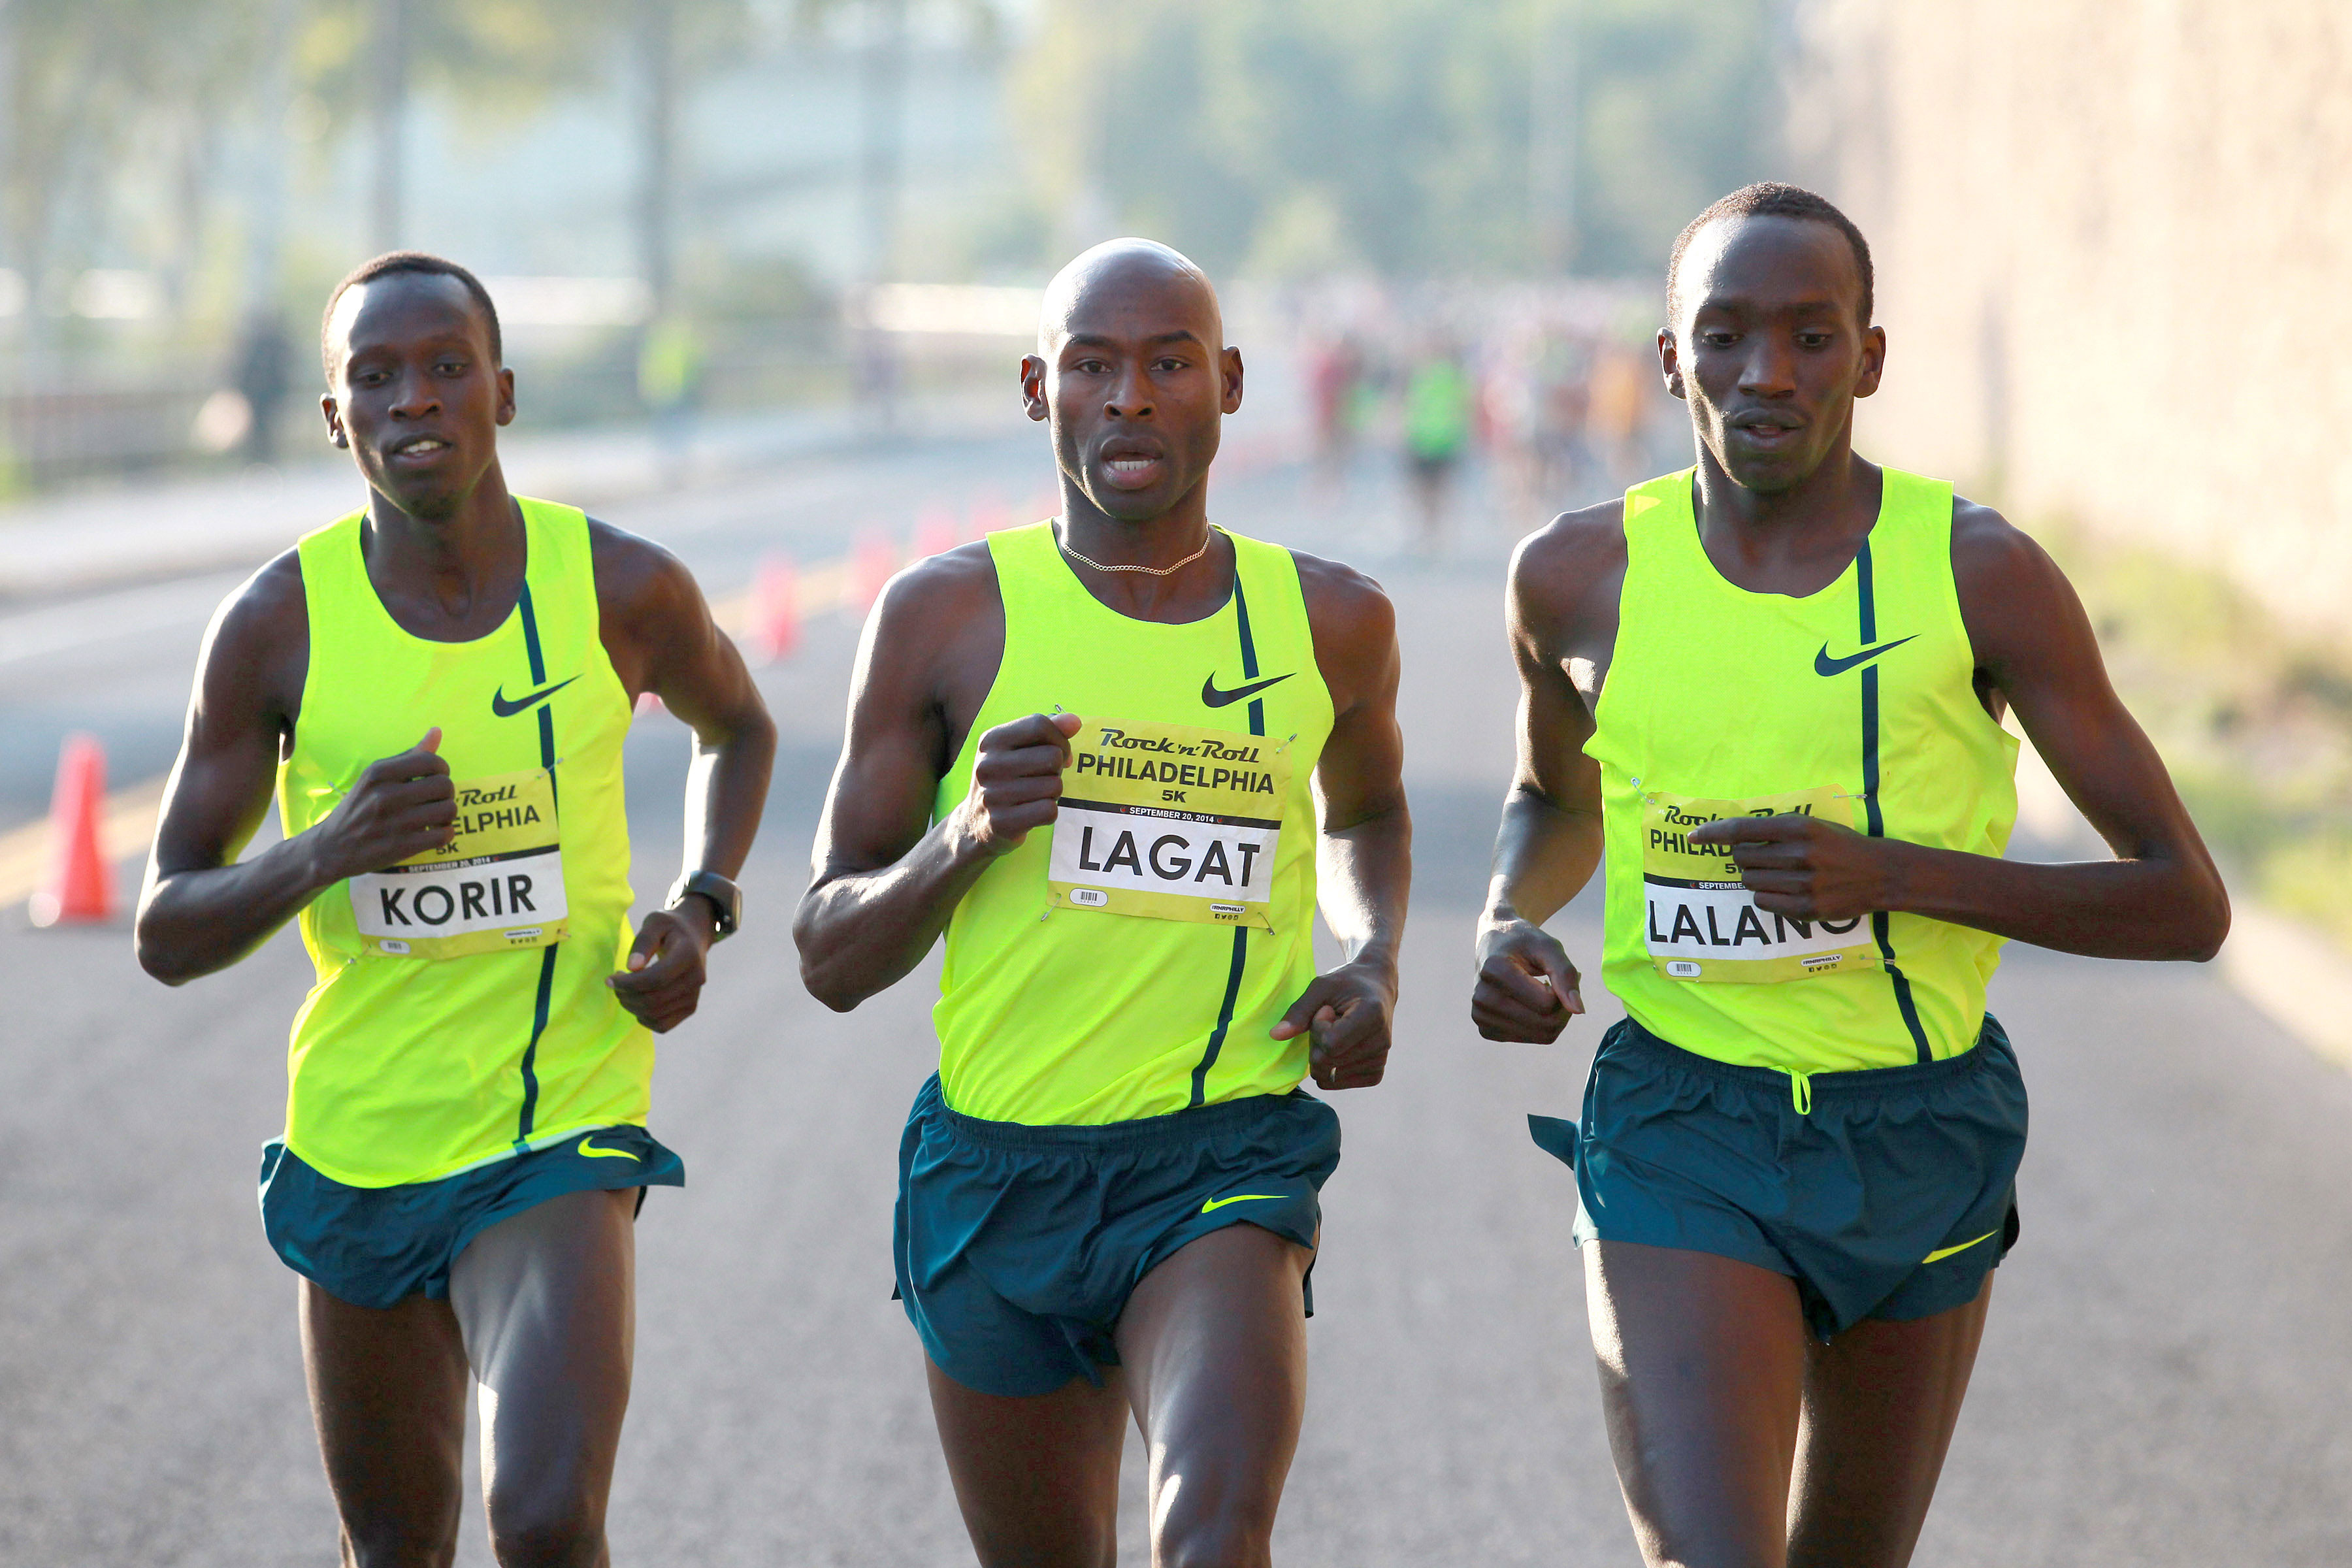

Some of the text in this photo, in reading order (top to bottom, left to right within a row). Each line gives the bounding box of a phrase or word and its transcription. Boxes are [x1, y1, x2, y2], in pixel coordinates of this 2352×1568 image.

[1077, 753, 1275, 794] PHILADELPHIA
[1162, 789, 1186, 803] 5K
[451, 804, 541, 836] ELPHIA
[1129, 807, 1215, 823] SEPTEMBER 20, 2014
[408, 861, 457, 874] SEPTEMBER
[472, 856, 491, 866] 2014
[1079, 826, 1260, 887] LAGAT
[1725, 863, 1742, 874] 5
[380, 874, 536, 926] KORIR
